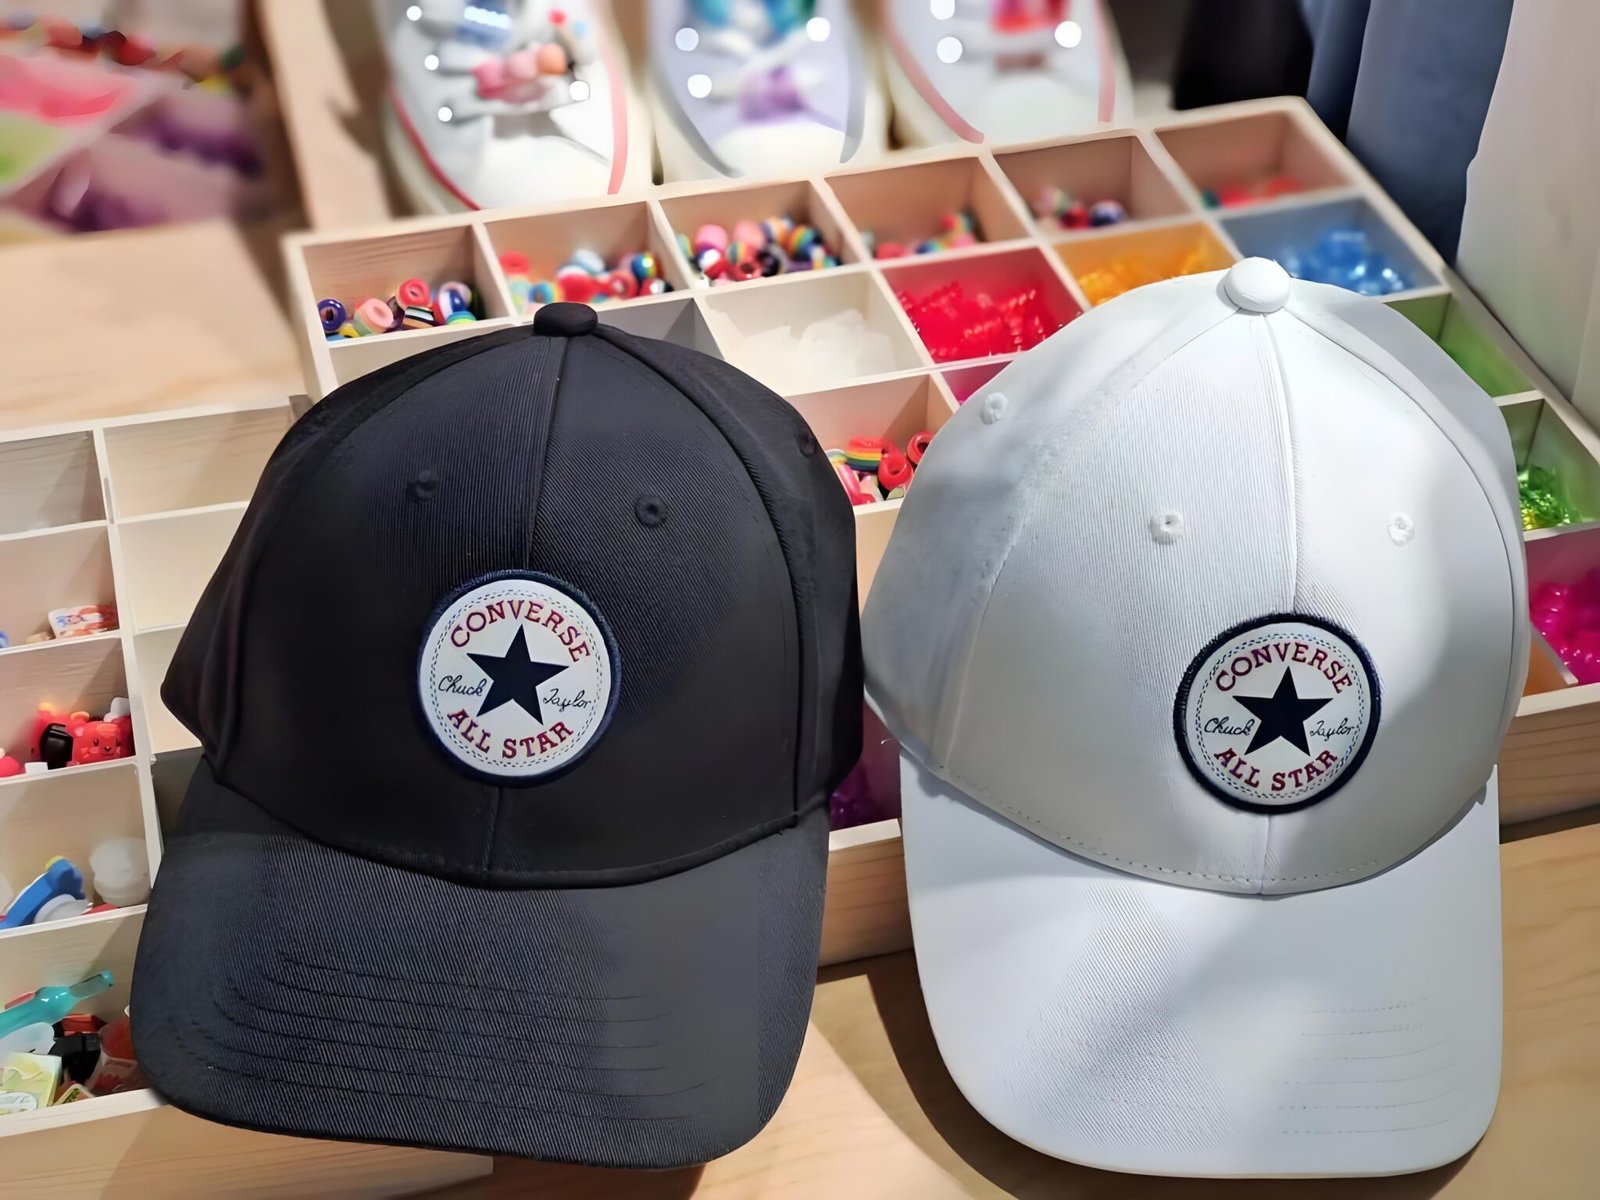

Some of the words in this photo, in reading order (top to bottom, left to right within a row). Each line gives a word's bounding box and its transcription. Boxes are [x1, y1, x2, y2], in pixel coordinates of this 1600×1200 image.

[451, 600, 590, 662] CONVERSE
[438, 675, 487, 696] Chuck
[1216, 642, 1353, 693] CONVERSE
[447, 708, 491, 753] ALL
[502, 721, 573, 759] STAR
[1204, 716, 1255, 736] Chuck
[1214, 748, 1260, 788] ALL
[1271, 750, 1338, 791] STAR
